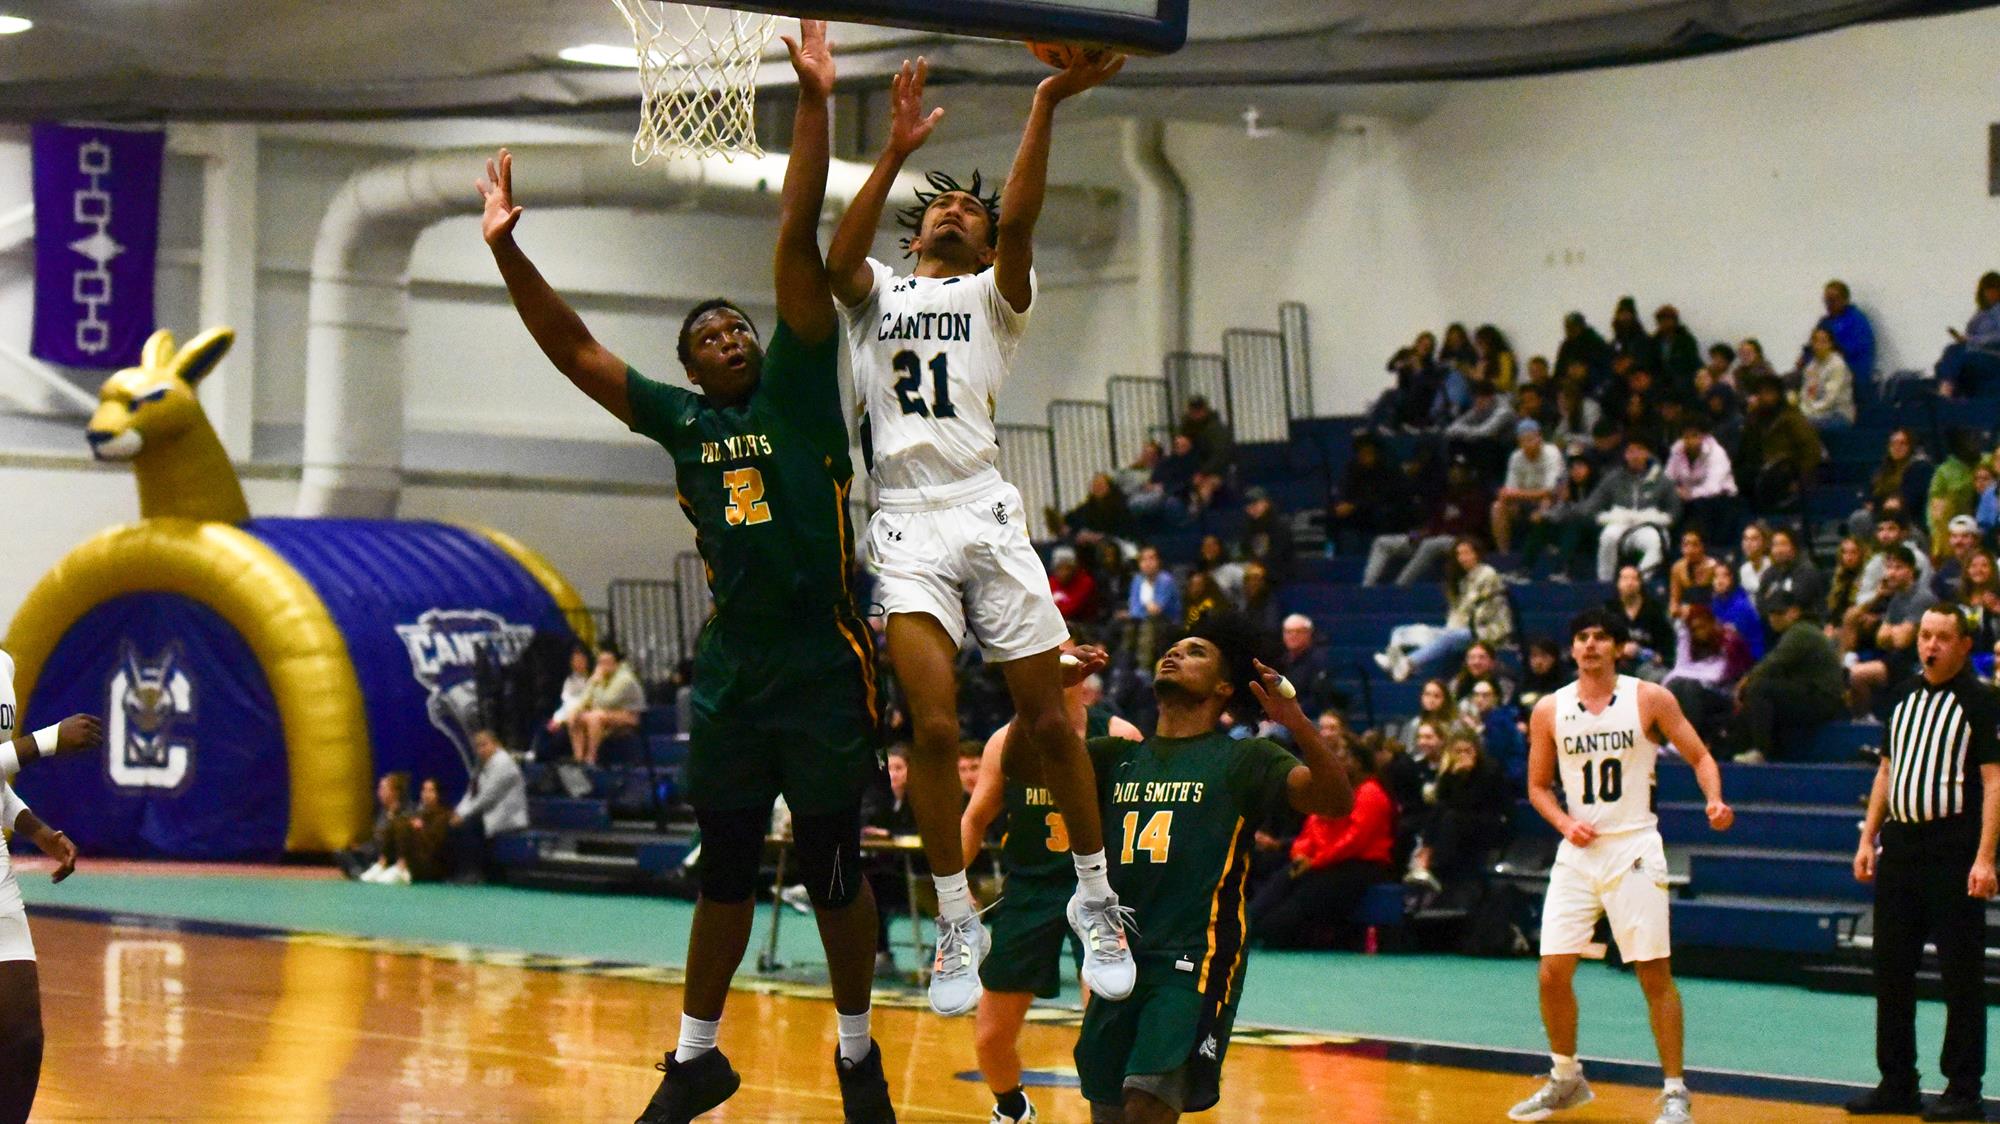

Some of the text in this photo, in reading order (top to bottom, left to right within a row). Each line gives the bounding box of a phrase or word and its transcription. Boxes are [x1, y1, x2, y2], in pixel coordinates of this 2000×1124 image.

[878, 312, 971, 342] CANTON
[892, 349, 957, 418] 21
[724, 434, 772, 460] MITH'S
[723, 466, 772, 526] 32
[1563, 729, 1634, 755] CANTON
[1112, 782, 1204, 804] PAUL SMITH'S
[1582, 757, 1622, 805] 10
[1025, 788, 1054, 806] PAUL
[1120, 810, 1174, 864] 14
